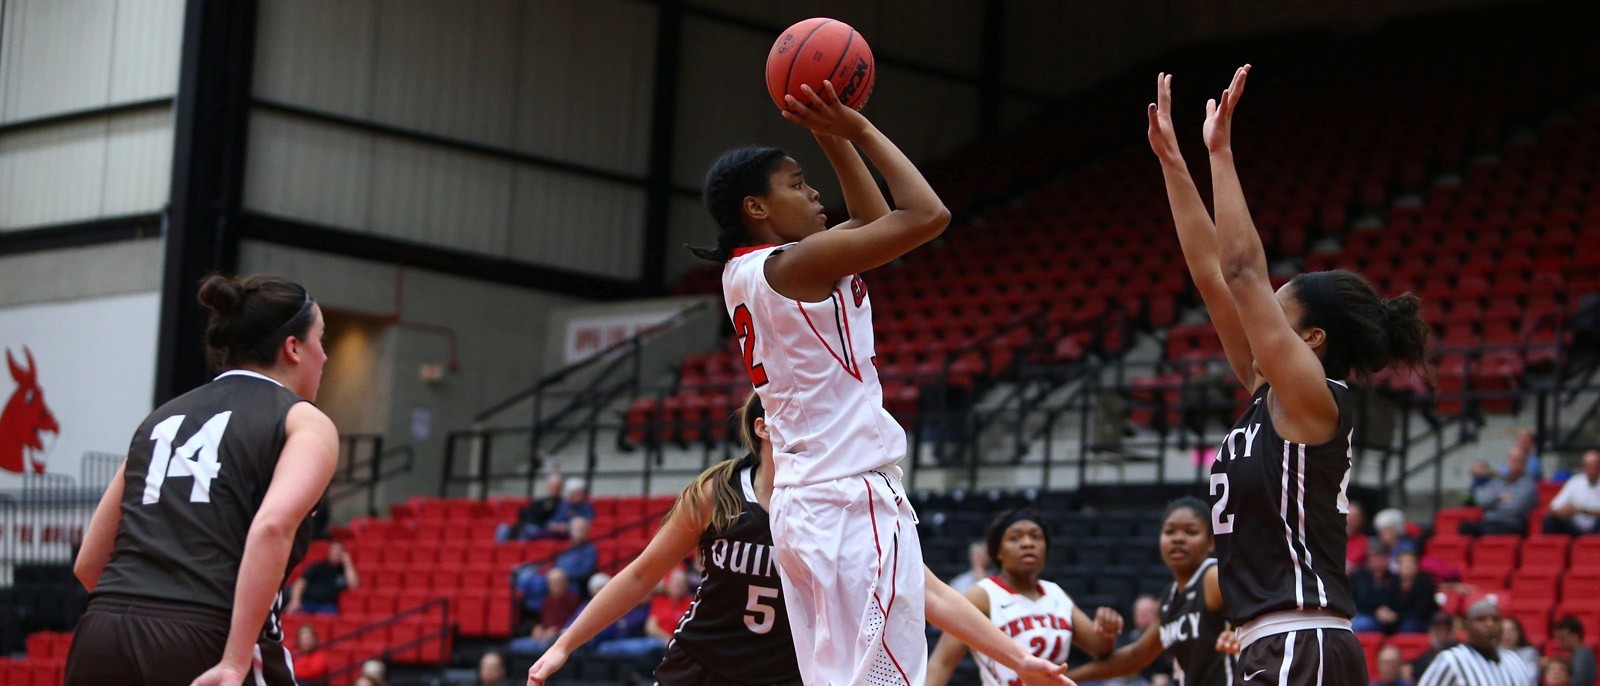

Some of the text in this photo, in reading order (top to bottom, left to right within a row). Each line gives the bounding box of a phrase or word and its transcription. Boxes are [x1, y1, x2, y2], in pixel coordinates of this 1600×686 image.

[733, 302, 769, 388] 2
[142, 410, 233, 505] 14
[1209, 472, 1235, 535] 2
[743, 584, 779, 635] 5
